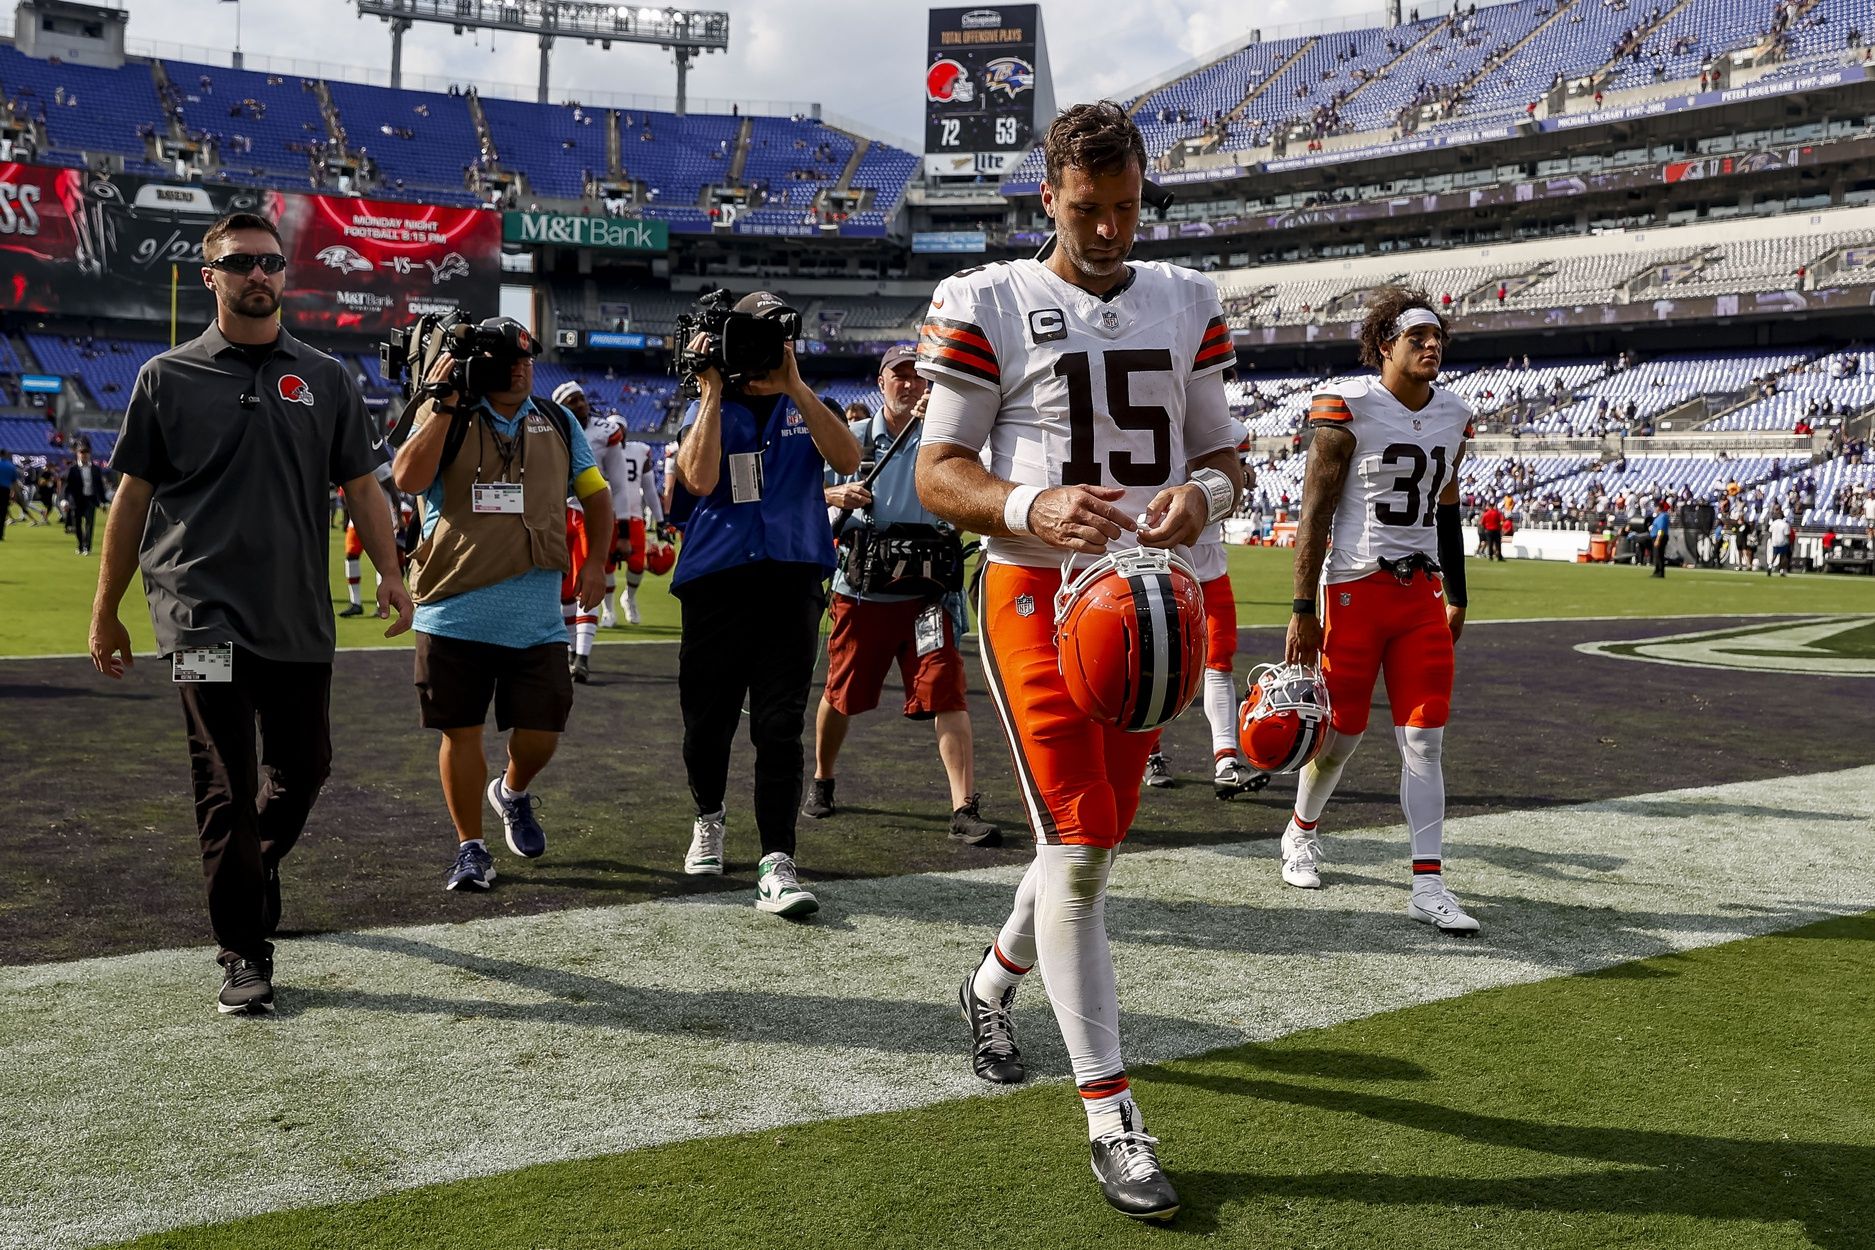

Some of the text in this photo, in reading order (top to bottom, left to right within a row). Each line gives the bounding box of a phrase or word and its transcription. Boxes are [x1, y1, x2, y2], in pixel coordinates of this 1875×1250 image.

[999, 28, 1022, 42] PLAYS
[1722, 88, 1747, 101] PETER
[941, 119, 960, 146] 72
[995, 117, 1016, 145] 53
[974, 153, 1004, 173] Lite
[352, 214, 438, 231] MONDAY NIGHT
[520, 212, 653, 248] M&T Bank
[344, 226, 447, 244] FOOTBALL 8:15 PM
[393, 256, 411, 274] VS
[1031, 310, 1064, 335] C
[1053, 348, 1173, 487] 15
[527, 424, 554, 434] MEDIA
[1375, 442, 1447, 528] 31
